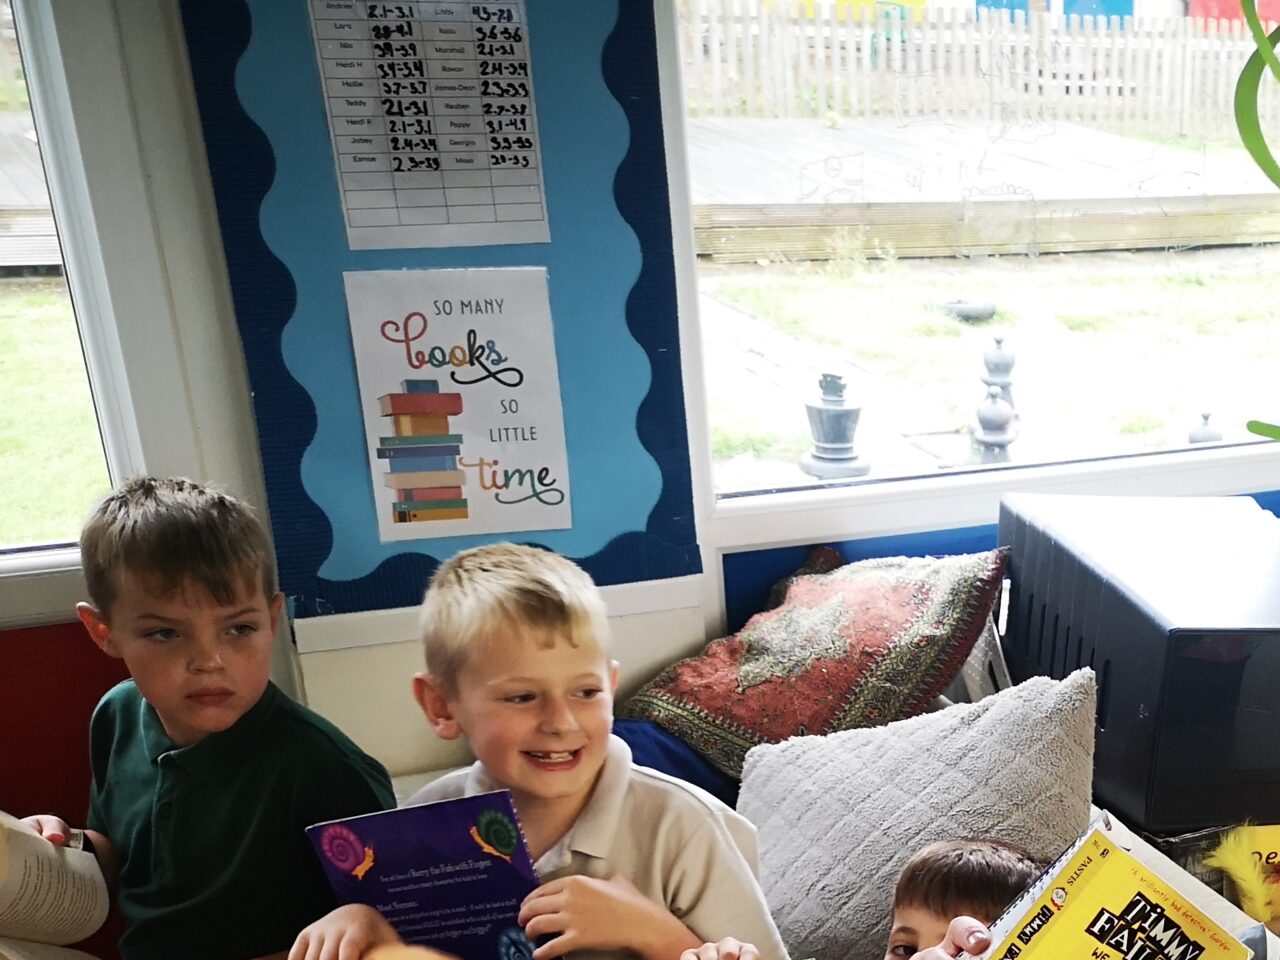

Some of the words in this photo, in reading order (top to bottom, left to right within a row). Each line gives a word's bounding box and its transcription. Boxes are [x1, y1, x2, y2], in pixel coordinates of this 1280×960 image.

[433, 299, 453, 316] SO
[460, 298, 505, 315] MANY
[380, 311, 524, 388] books
[500, 398, 519, 414] SO
[489, 426, 538, 443] LITTLE
[459, 456, 565, 506] time
[1066, 856, 1093, 887] PASTIS
